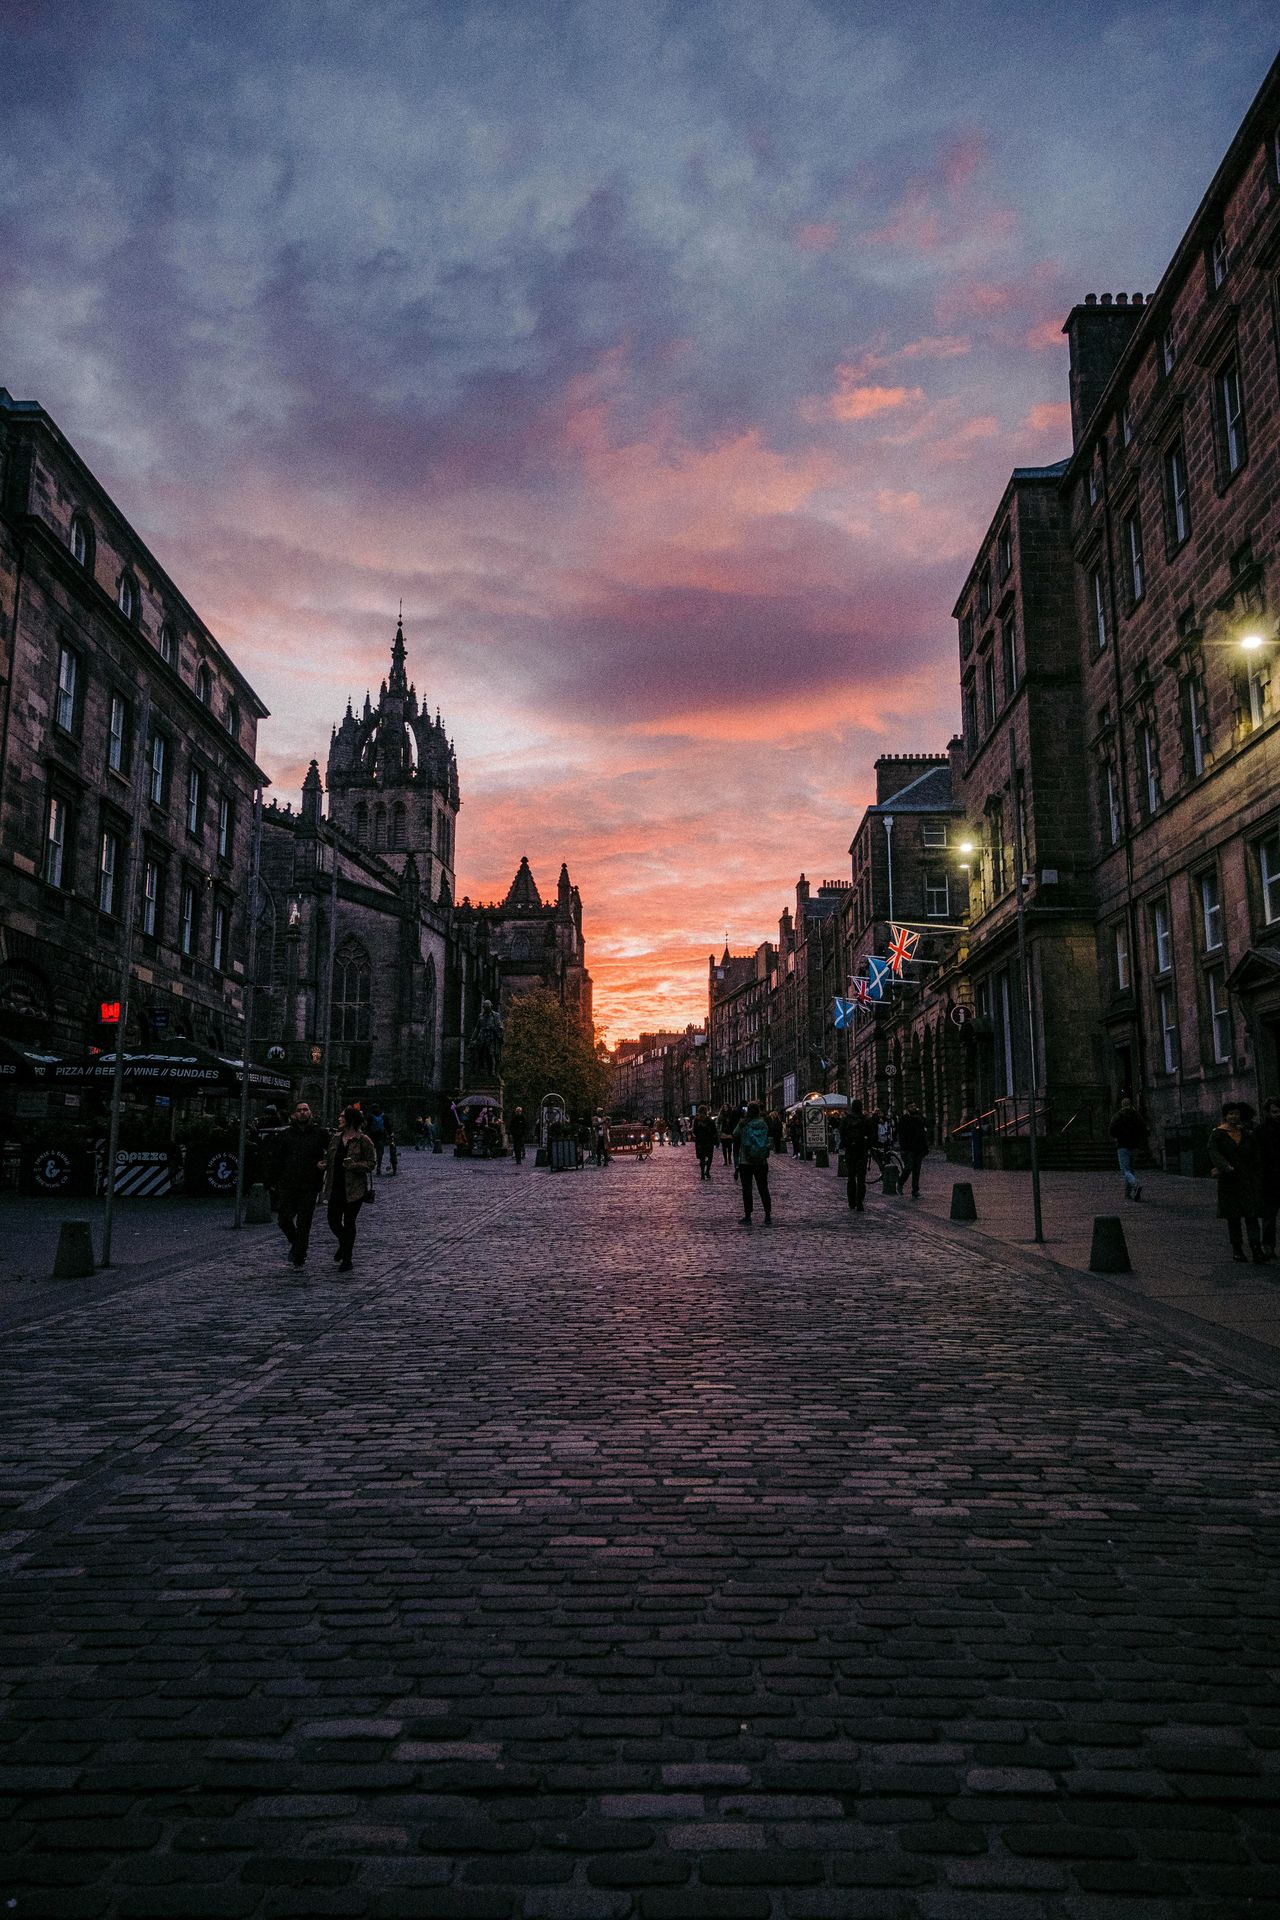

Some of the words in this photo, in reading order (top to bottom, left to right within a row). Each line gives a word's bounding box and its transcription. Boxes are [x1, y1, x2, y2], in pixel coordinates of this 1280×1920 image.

[55, 1067, 84, 1076] PIZZA
[95, 1067, 117, 1076] BEE
[133, 1068, 160, 1076] WINE
[169, 1069, 220, 1079] SUNDAES
